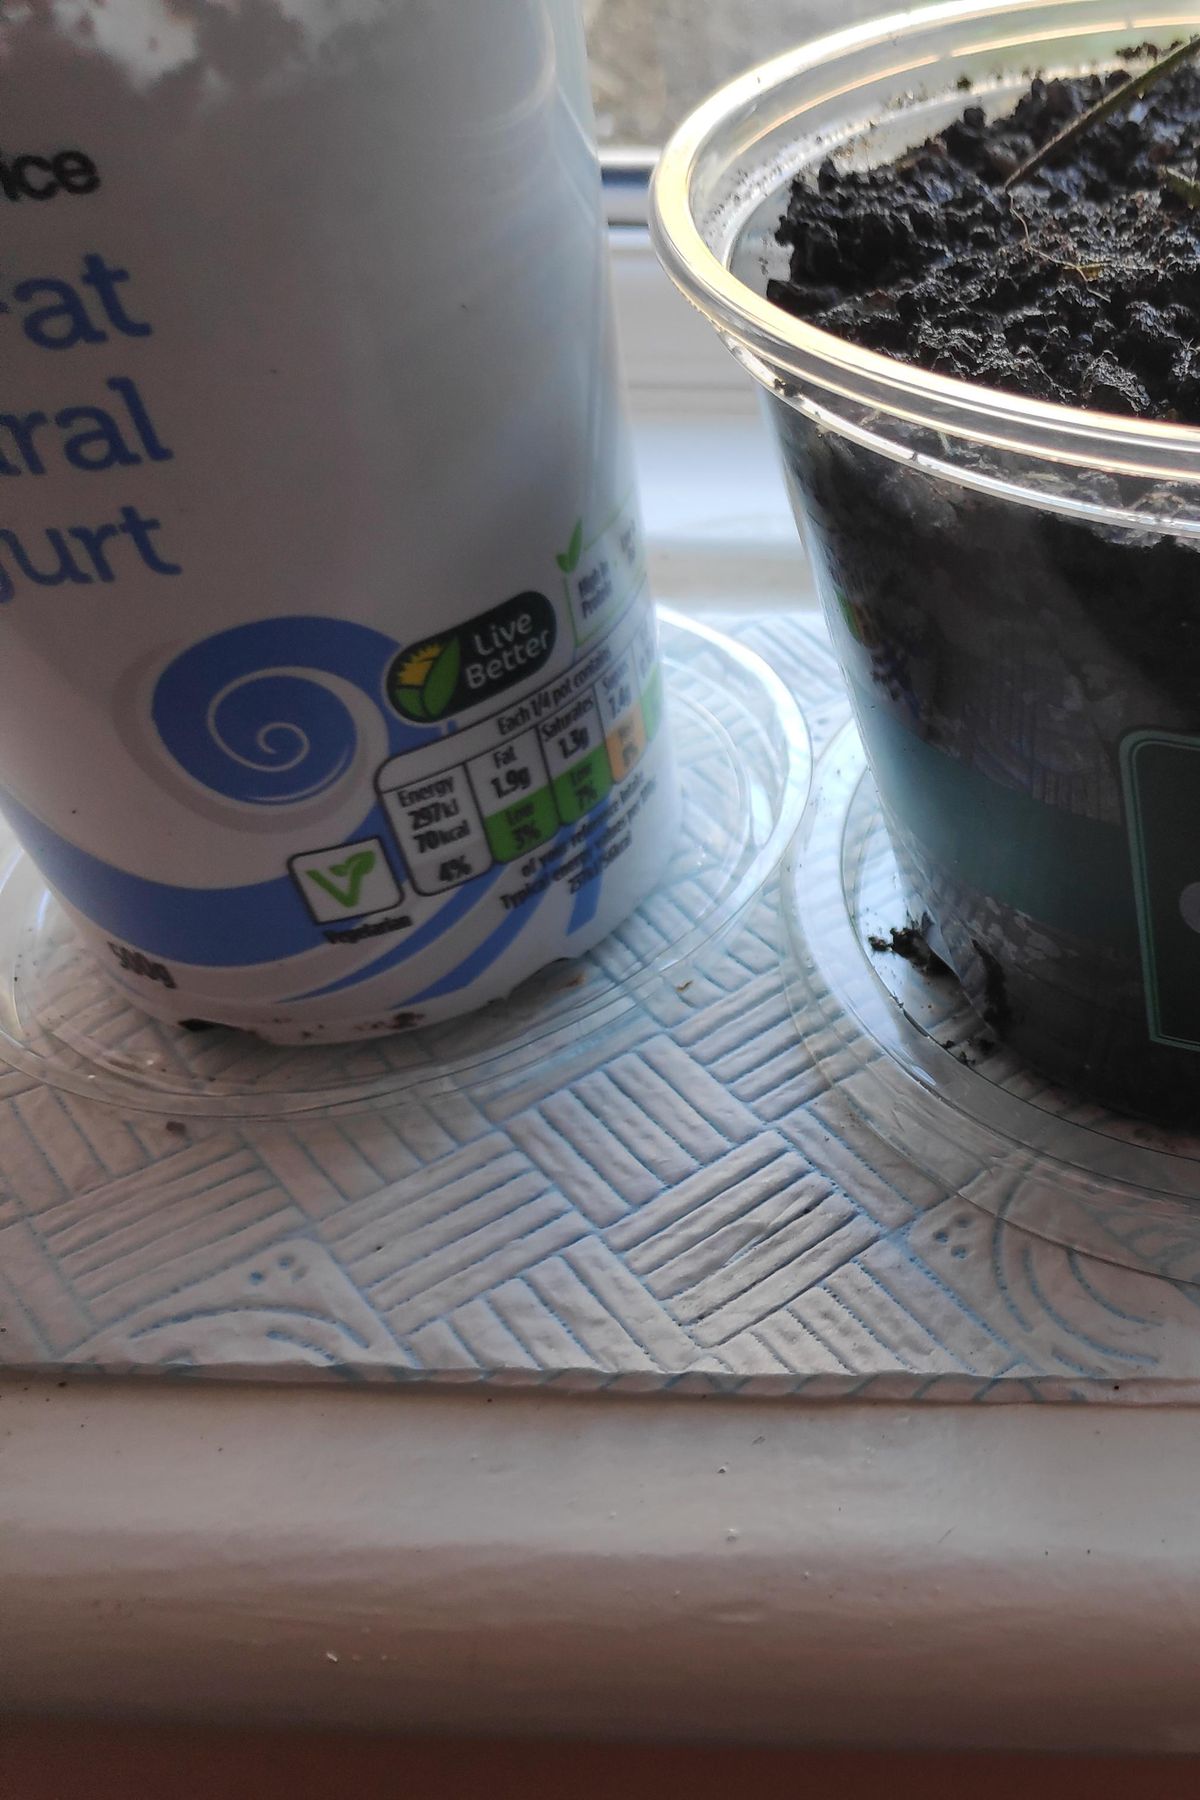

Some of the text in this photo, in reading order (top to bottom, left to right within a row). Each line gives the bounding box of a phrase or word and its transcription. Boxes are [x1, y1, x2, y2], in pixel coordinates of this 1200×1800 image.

[0, 253, 153, 351] at
[474, 612, 533, 656] Live
[464, 630, 550, 690] Better
[497, 706, 531, 735] Each
[493, 746, 518, 769] Fat
[397, 776, 455, 807] Energy
